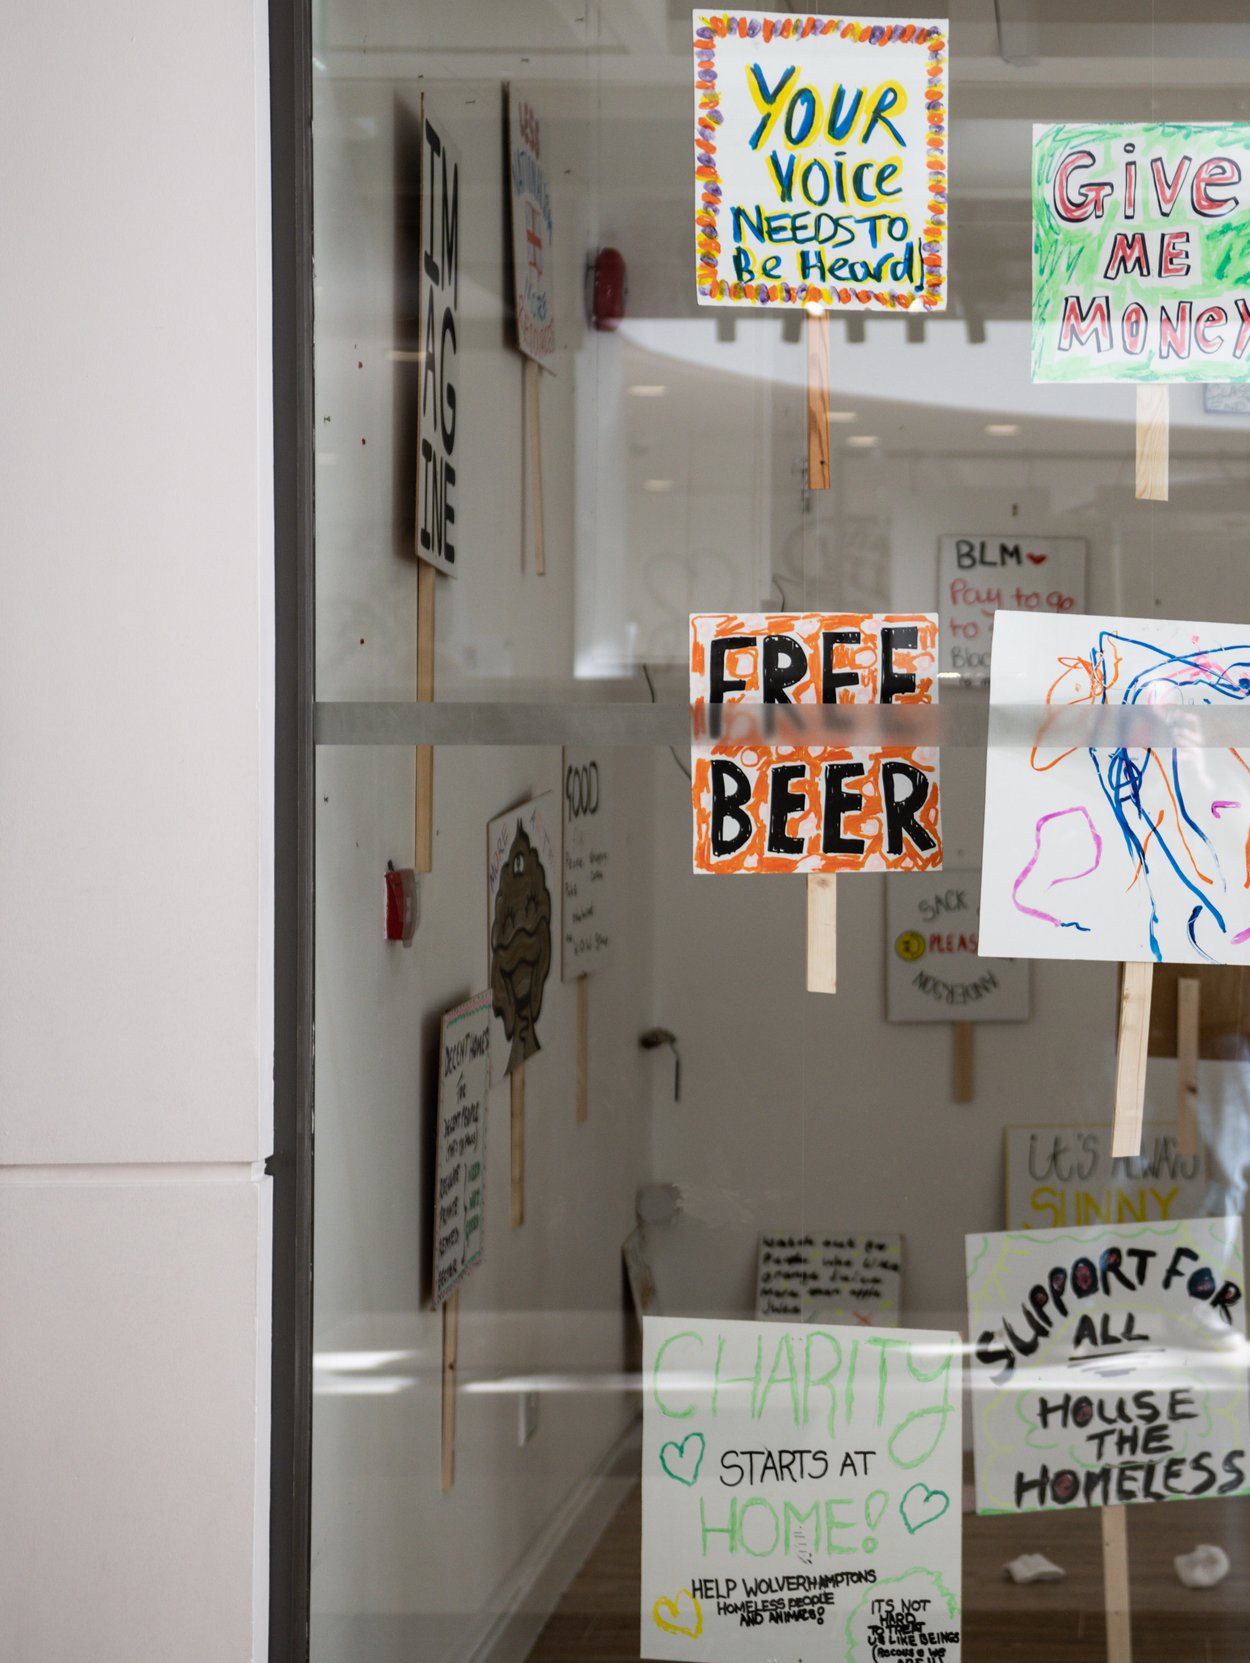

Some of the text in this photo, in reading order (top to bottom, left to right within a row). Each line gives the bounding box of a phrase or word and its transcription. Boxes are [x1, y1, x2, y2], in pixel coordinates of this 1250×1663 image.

[746, 62, 907, 151] YOUR
[730, 204, 909, 248] NEEDS TO
[732, 245, 783, 283] Be
[1103, 231, 1192, 280] ME
[955, 539, 1022, 570] BLM
[1012, 586, 1041, 609] to
[709, 626, 918, 739] FREE
[710, 759, 937, 857] BEER
[1024, 1186, 1180, 1229] SUNNY
[975, 1247, 1157, 1386] SUPPORT
[1161, 1246, 1242, 1326] FOR
[1073, 1312, 1150, 1349] ALL
[1037, 1387, 1199, 1429] HOUSE
[1086, 1424, 1174, 1462] THE
[720, 1449, 877, 1488] STARTS AT
[1014, 1449, 1246, 1509] HOMELESS
[700, 1489, 889, 1557] HOME!
[691, 1578, 738, 1600] HELP
[717, 1598, 785, 1616] HOMELESS
[901, 1598, 932, 1613] NOT
[740, 1611, 764, 1627] AND
[879, 1610, 917, 1627] HARD
[889, 1634, 918, 1647] LIKE
